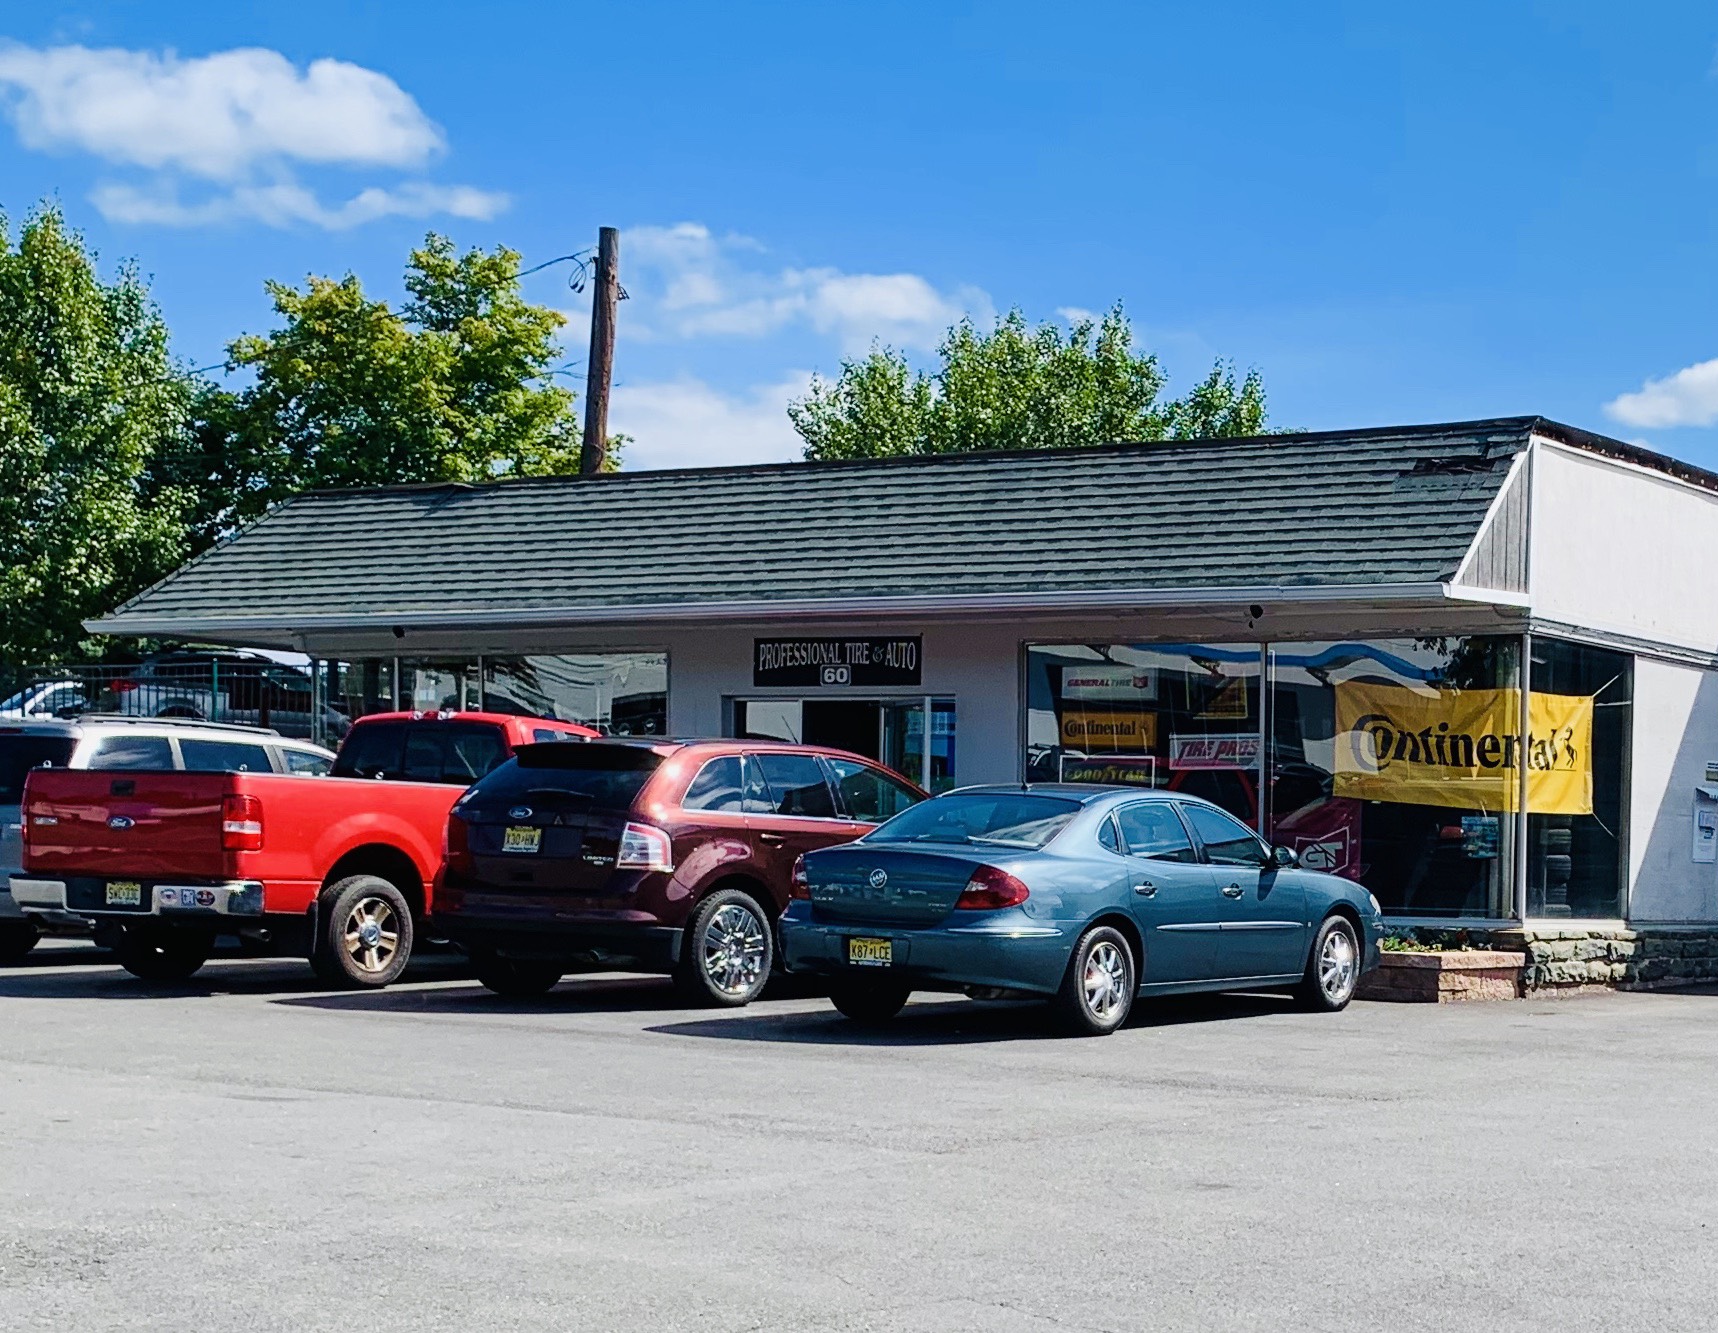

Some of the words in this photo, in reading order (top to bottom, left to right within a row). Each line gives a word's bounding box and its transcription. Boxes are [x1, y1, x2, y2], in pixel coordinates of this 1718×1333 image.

[758, 642, 842, 671] PROFESSIONAL
[845, 642, 870, 665] TIRE
[885, 642, 917, 671] AUTO
[823, 667, 849, 683] 60
[1064, 719, 1136, 737] Continental
[1178, 740, 1216, 760] TIRE
[1213, 739, 1260, 761] PROS
[1350, 713, 1558, 772] Continental
